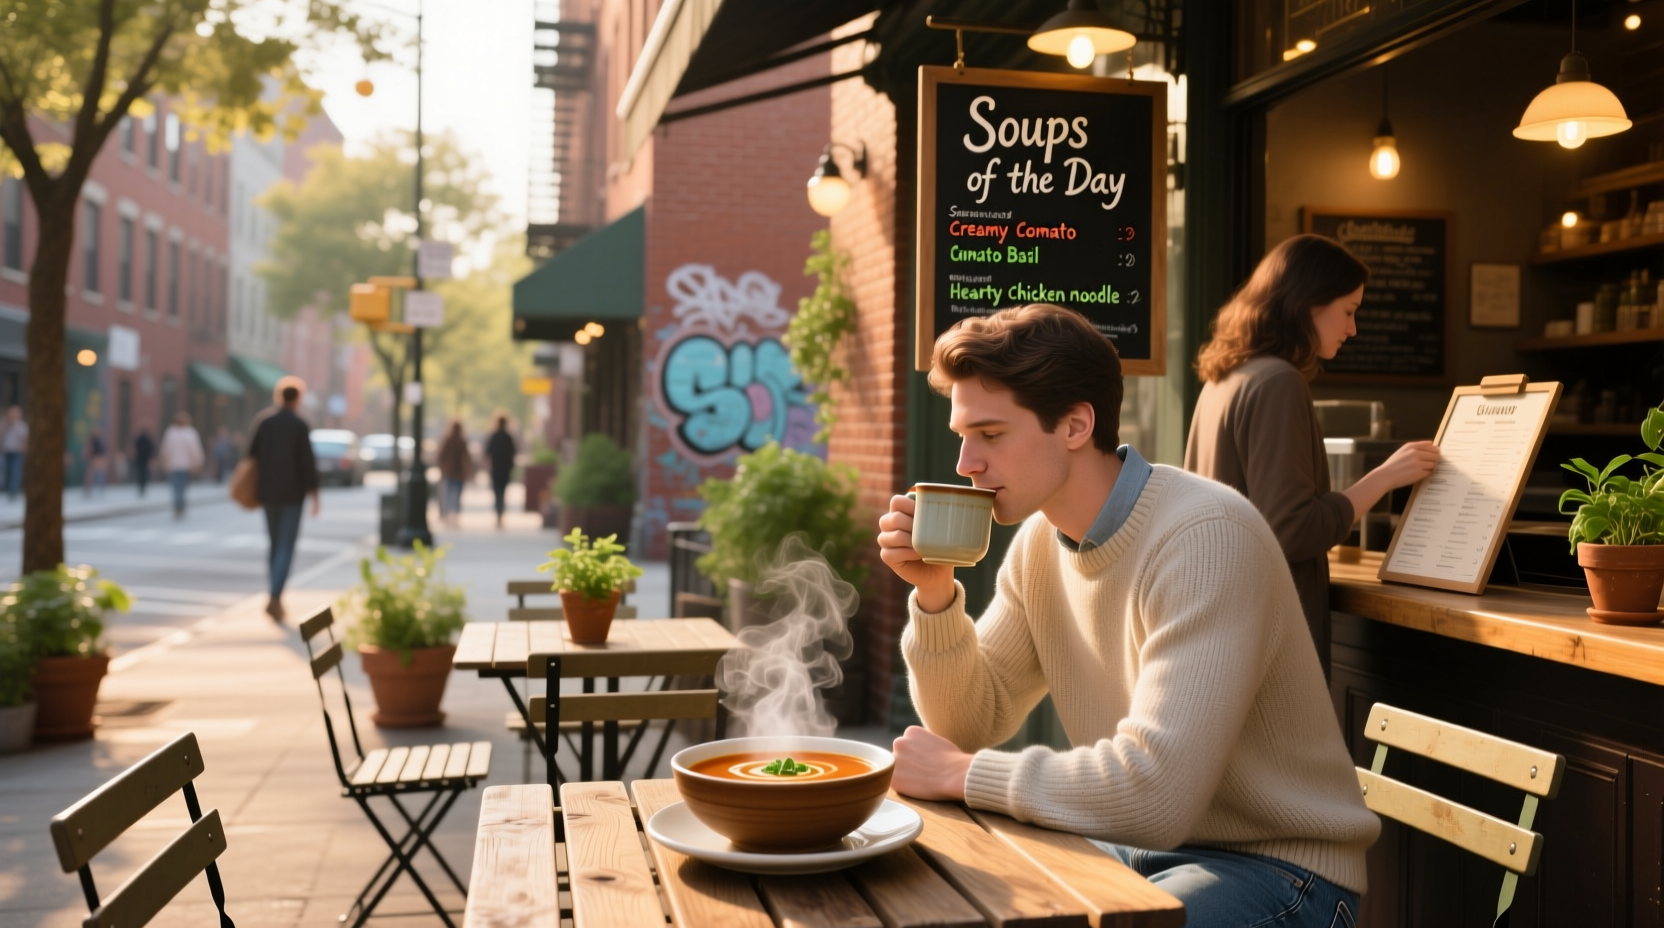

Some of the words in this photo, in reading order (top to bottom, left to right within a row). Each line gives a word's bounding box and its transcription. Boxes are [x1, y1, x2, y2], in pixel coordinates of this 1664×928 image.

[962, 95, 1089, 164] Soups
[966, 157, 1001, 204] of
[1006, 159, 1055, 194] the
[1063, 157, 1126, 211] Day
[949, 220, 1009, 245] Creamy
[950, 282, 1003, 307] Hearty
[1069, 284, 1120, 304] noodle
